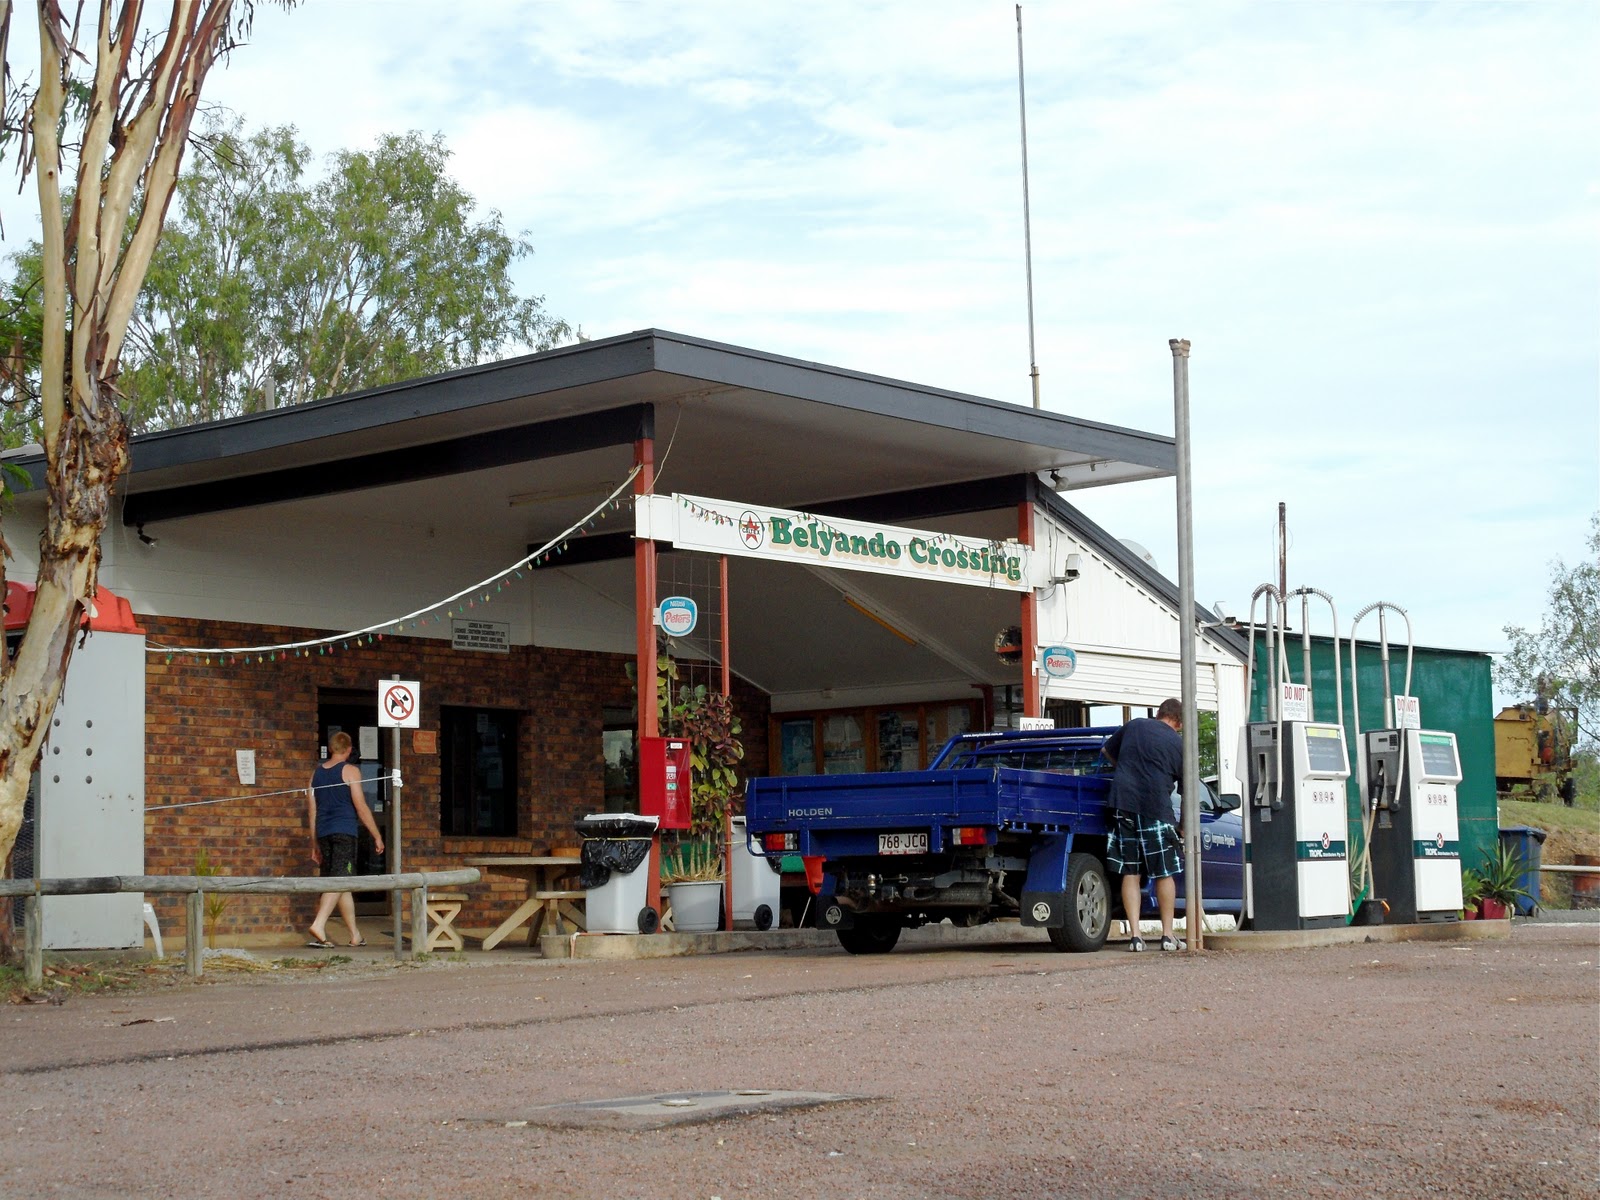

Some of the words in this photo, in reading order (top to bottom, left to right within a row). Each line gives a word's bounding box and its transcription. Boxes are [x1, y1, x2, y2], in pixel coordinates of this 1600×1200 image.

[769, 515, 901, 560] Belyando
[909, 537, 1022, 581] Crossing
[664, 611, 691, 624] Peters
[1047, 657, 1070, 668] Peters
[1284, 686, 1292, 700] DO
[1293, 687, 1305, 701] NOT
[788, 807, 833, 817] HOLDEN
